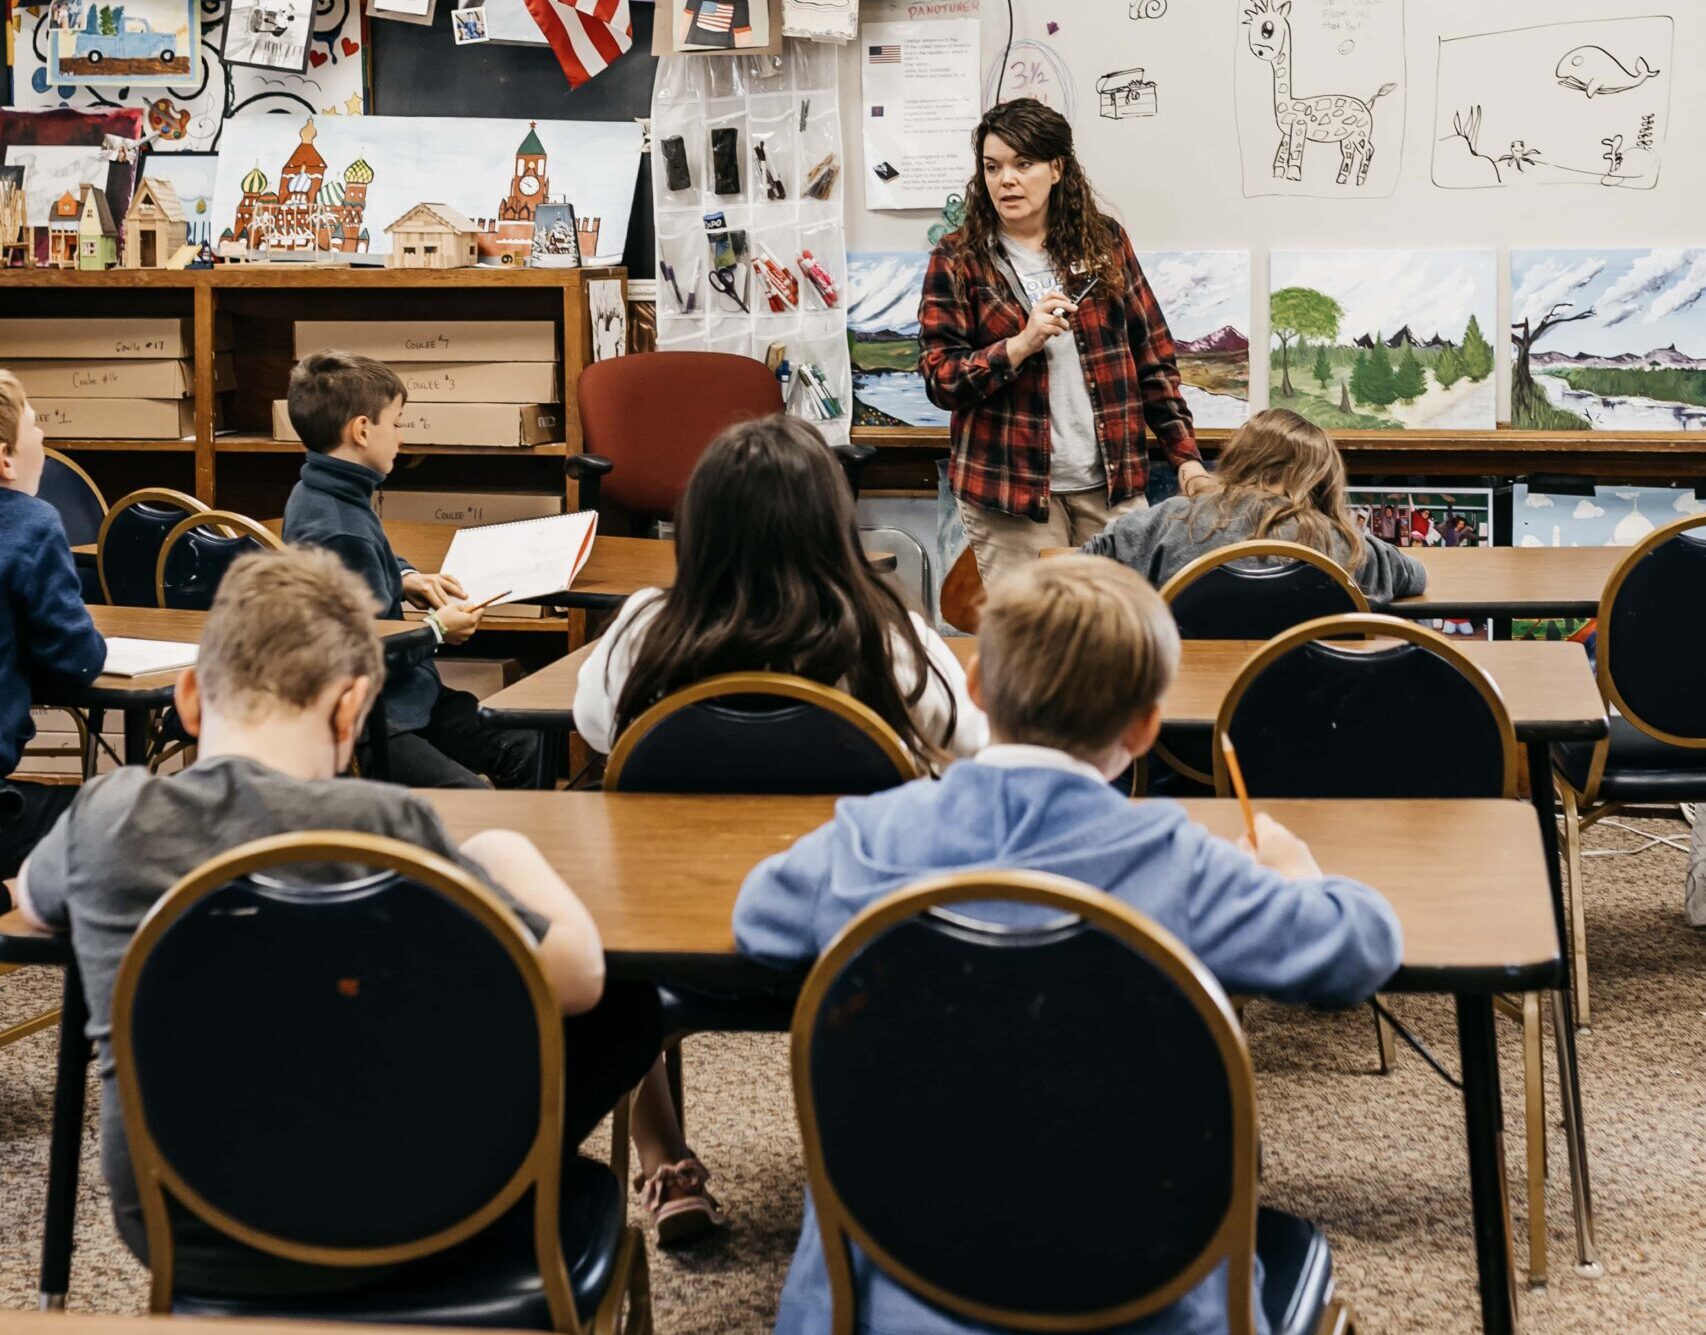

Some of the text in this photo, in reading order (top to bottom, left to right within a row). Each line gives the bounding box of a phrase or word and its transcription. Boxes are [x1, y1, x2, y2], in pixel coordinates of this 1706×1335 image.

[405, 334, 449, 350] COULEE #7
[406, 374, 456, 391] COULEE #3
[434, 506, 483, 521] COULEE #11
